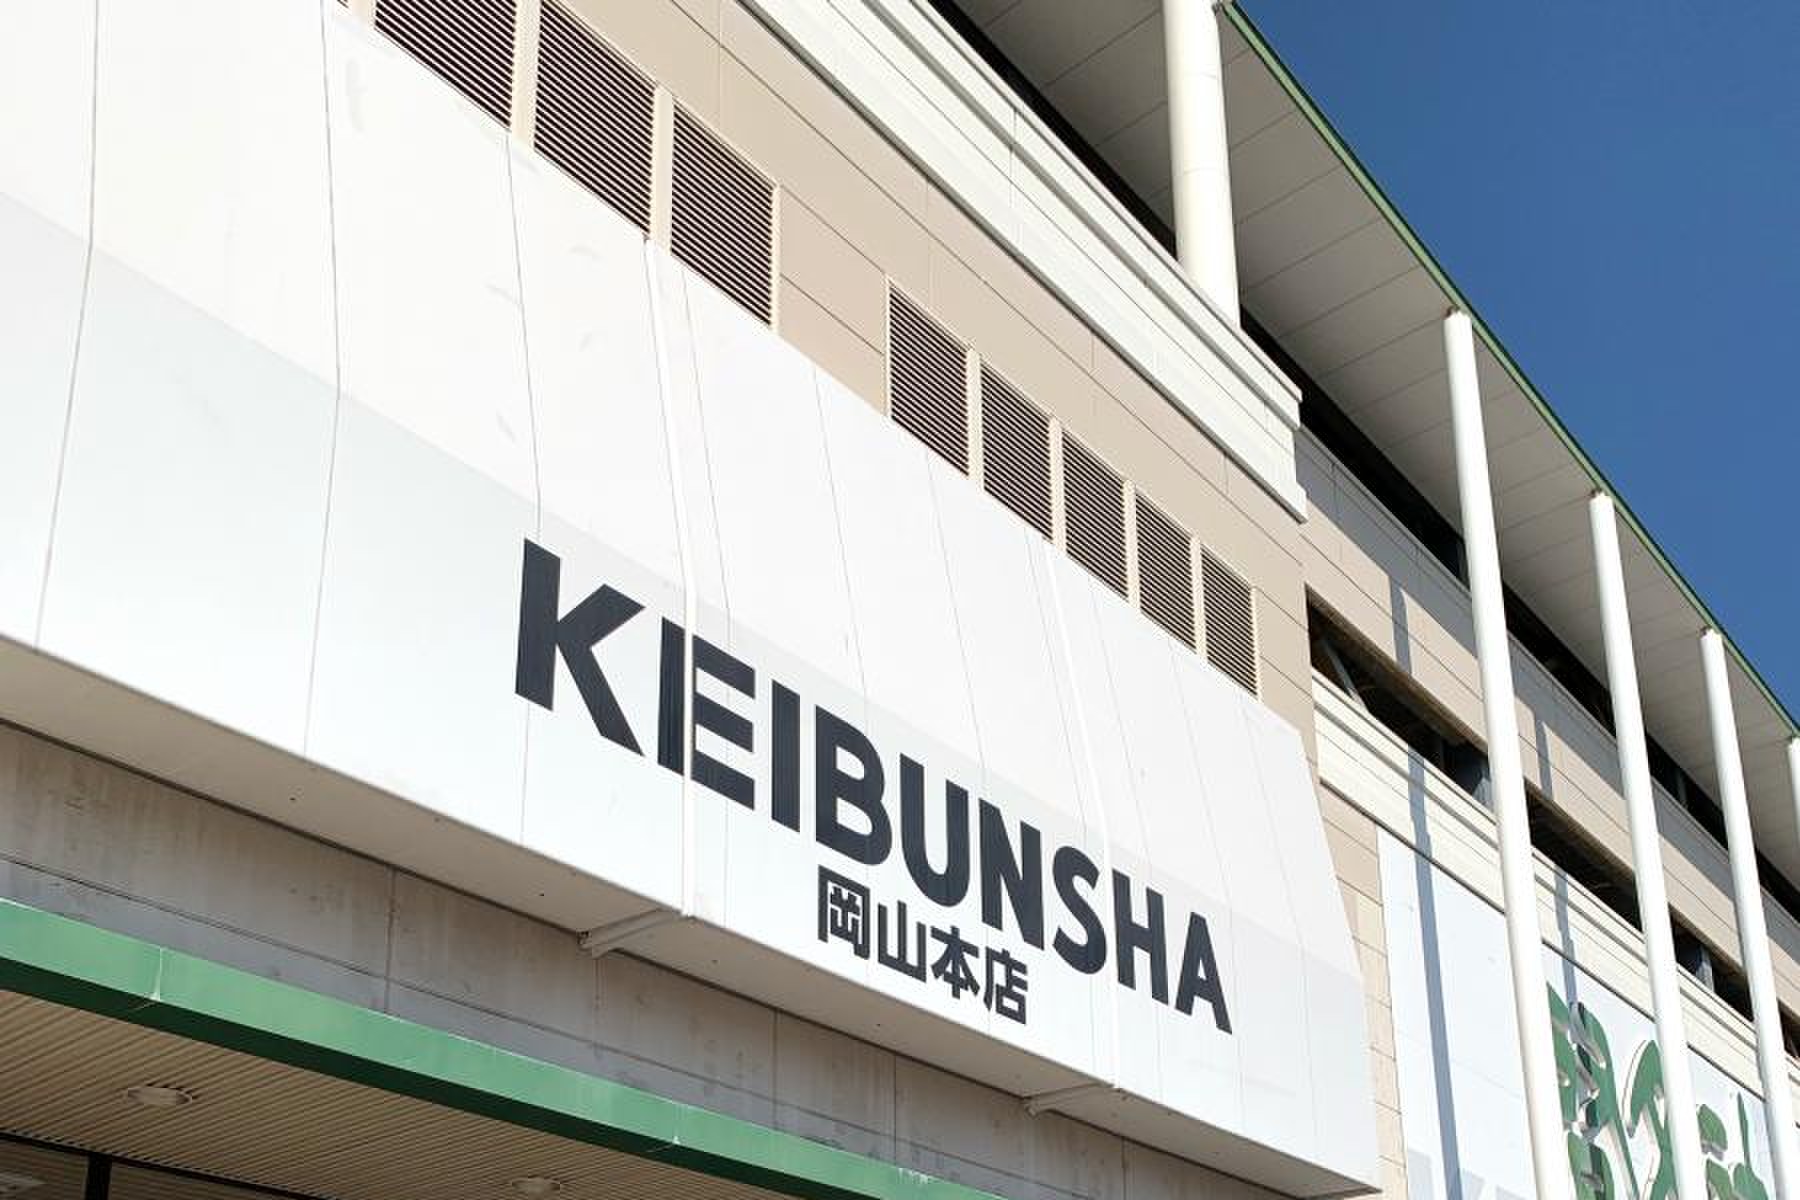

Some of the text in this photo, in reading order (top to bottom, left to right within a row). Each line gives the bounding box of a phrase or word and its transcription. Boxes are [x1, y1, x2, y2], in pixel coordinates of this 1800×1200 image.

[514, 537, 1233, 1035] KEIBUNSHA
[817, 864, 1028, 1025] 岡山本店
